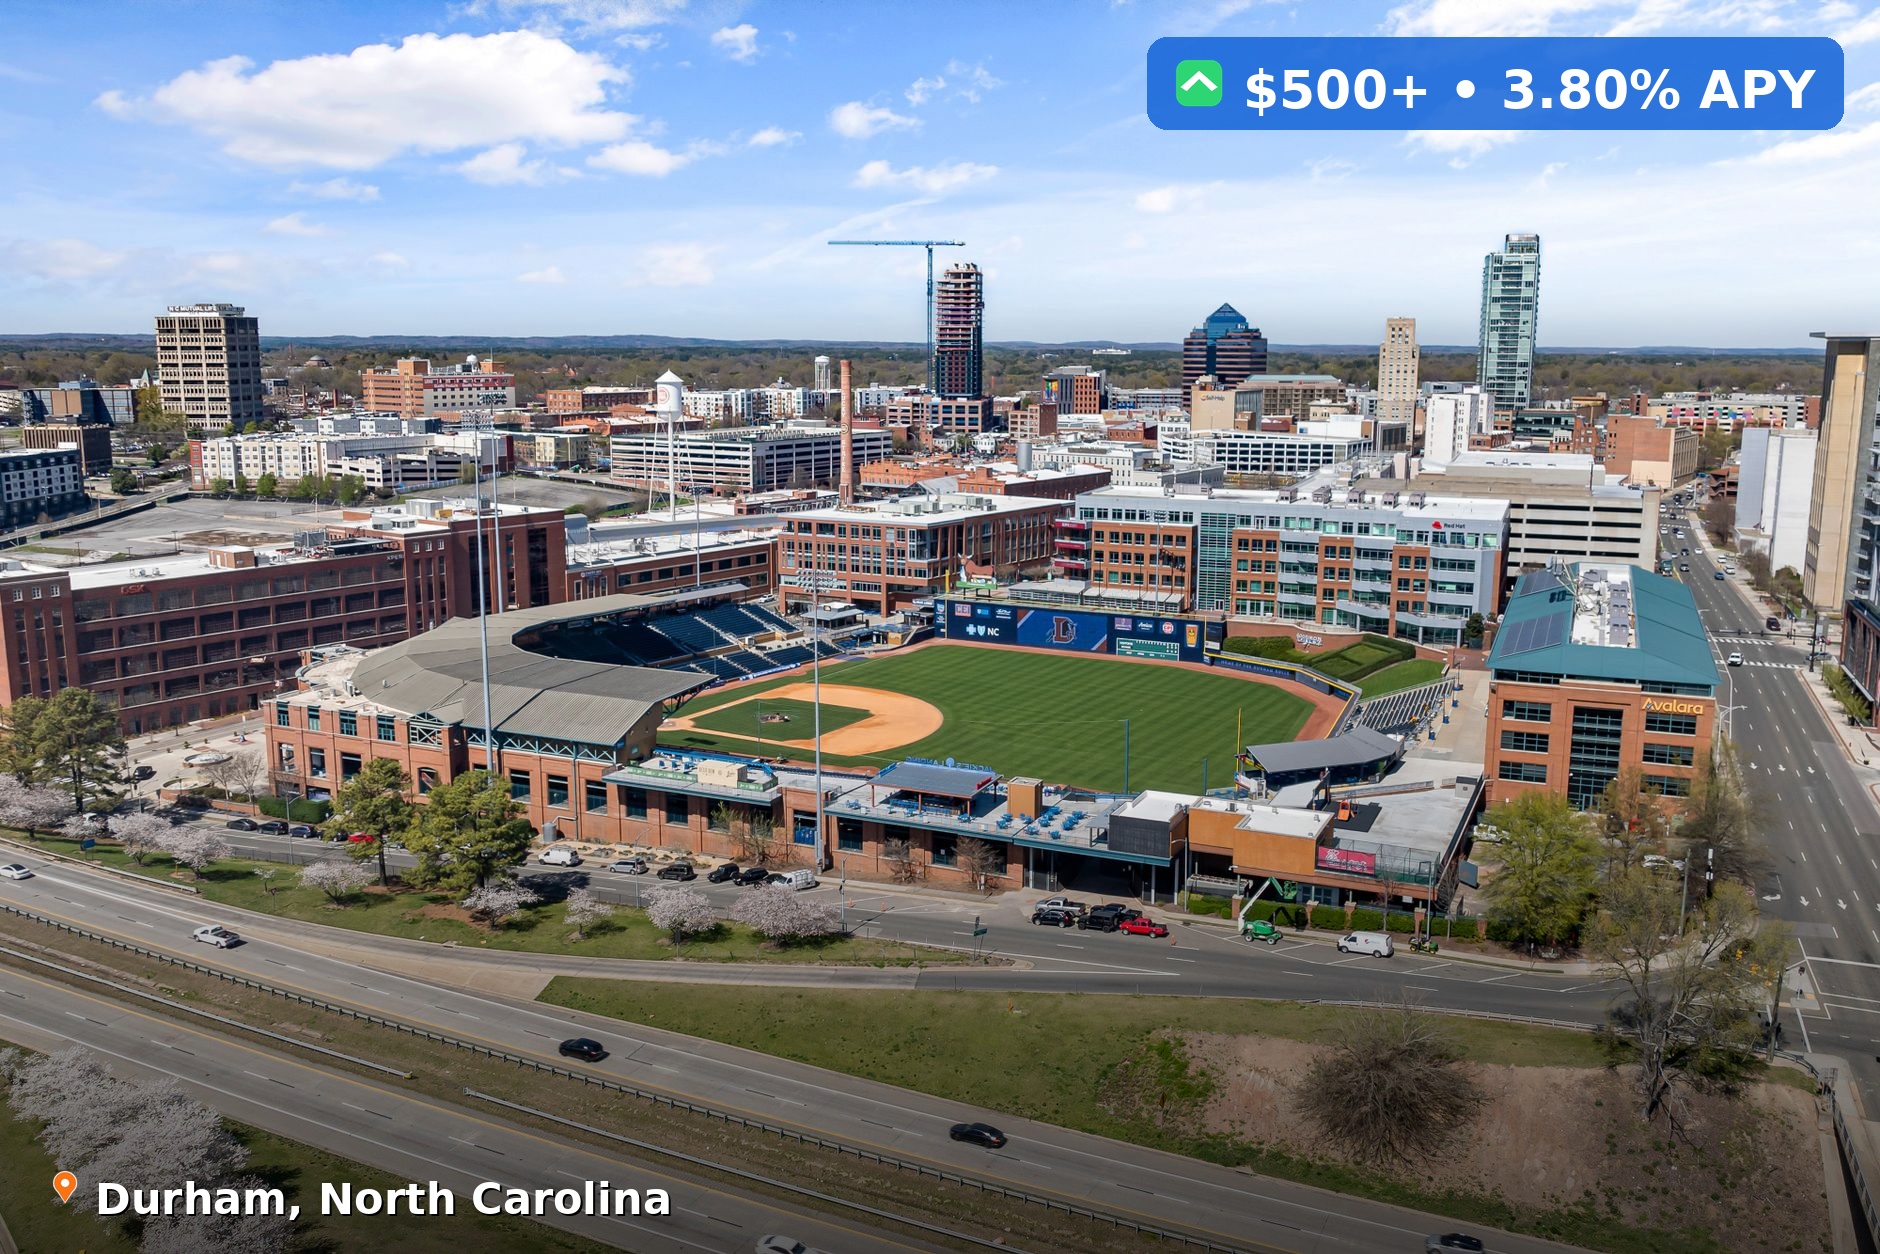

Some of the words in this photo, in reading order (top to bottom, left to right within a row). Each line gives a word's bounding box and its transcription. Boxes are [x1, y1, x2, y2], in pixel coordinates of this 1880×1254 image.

[120, 584, 145, 595] GSK
[987, 627, 1000, 637] NC
[1641, 697, 1704, 715] Avalara
